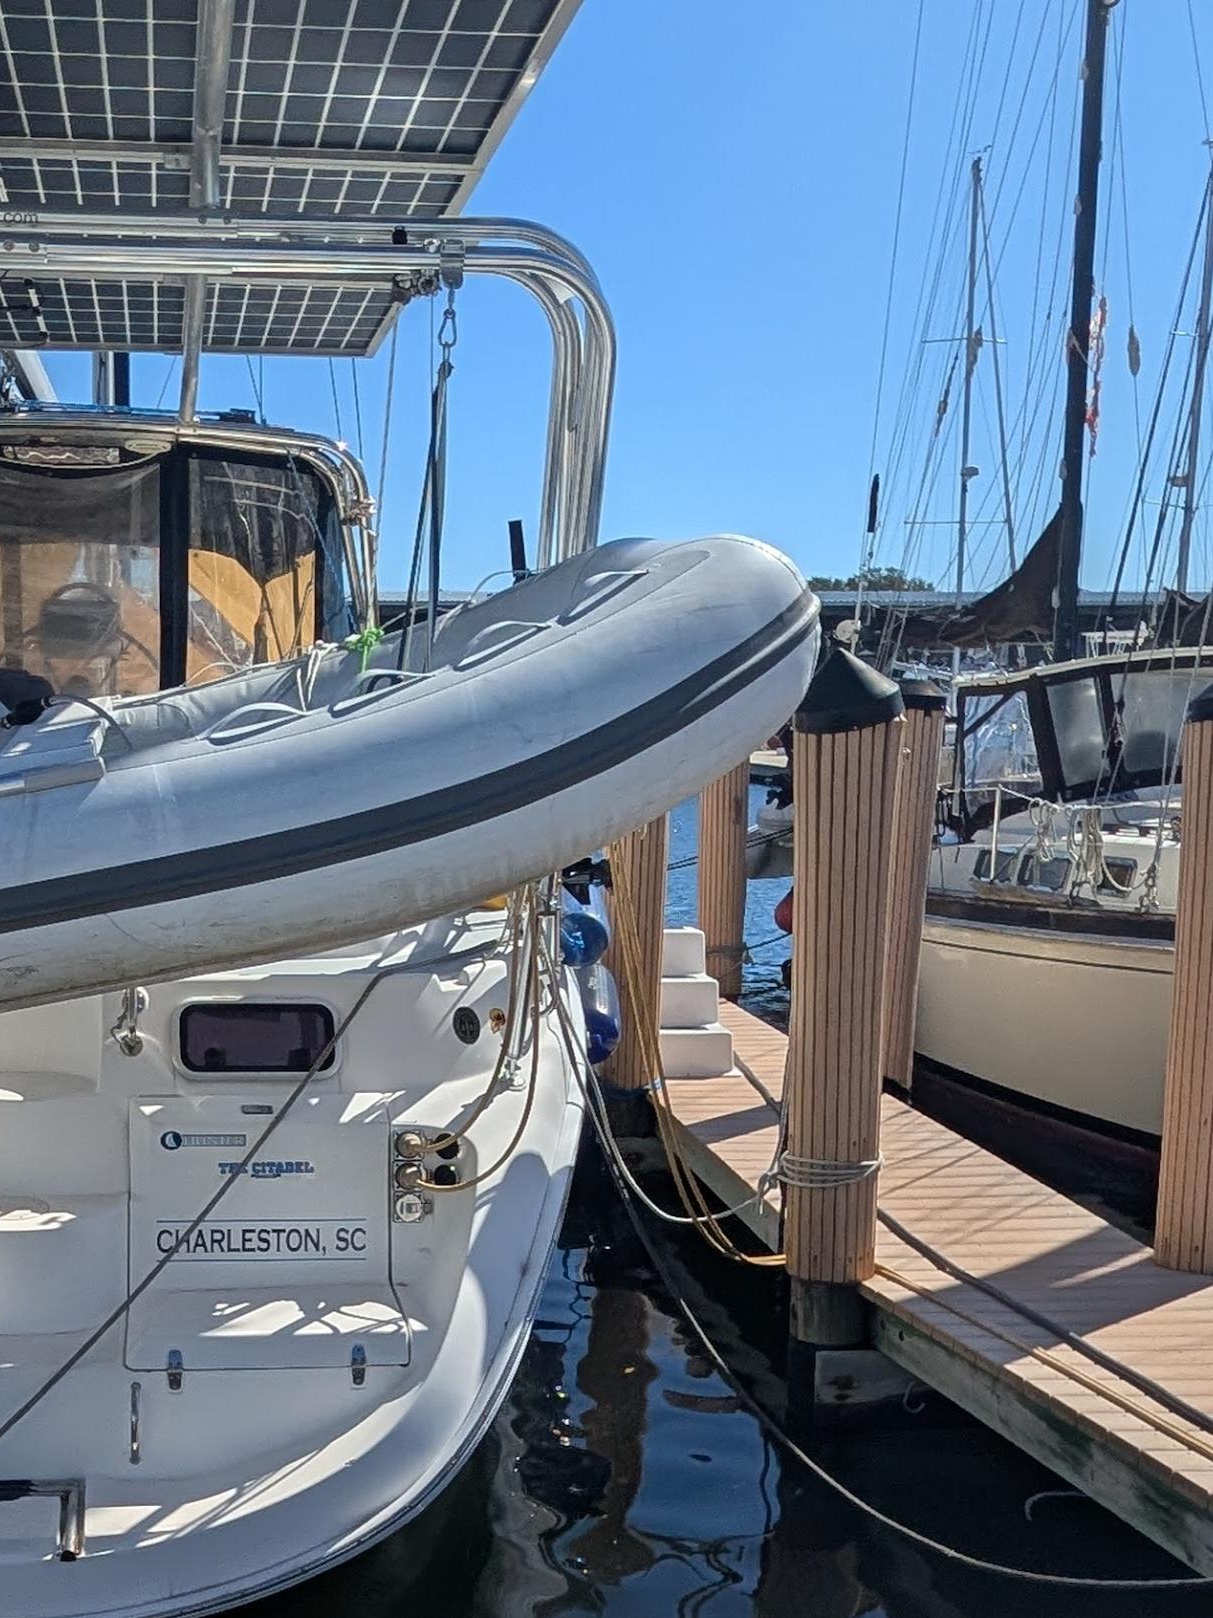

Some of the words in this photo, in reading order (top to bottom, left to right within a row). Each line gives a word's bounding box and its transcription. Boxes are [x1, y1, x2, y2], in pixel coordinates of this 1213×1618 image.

[251, 1161, 315, 1175] CITADEL
[156, 1228, 327, 1255] CHARLESTON,
[335, 1227, 367, 1252] SC
